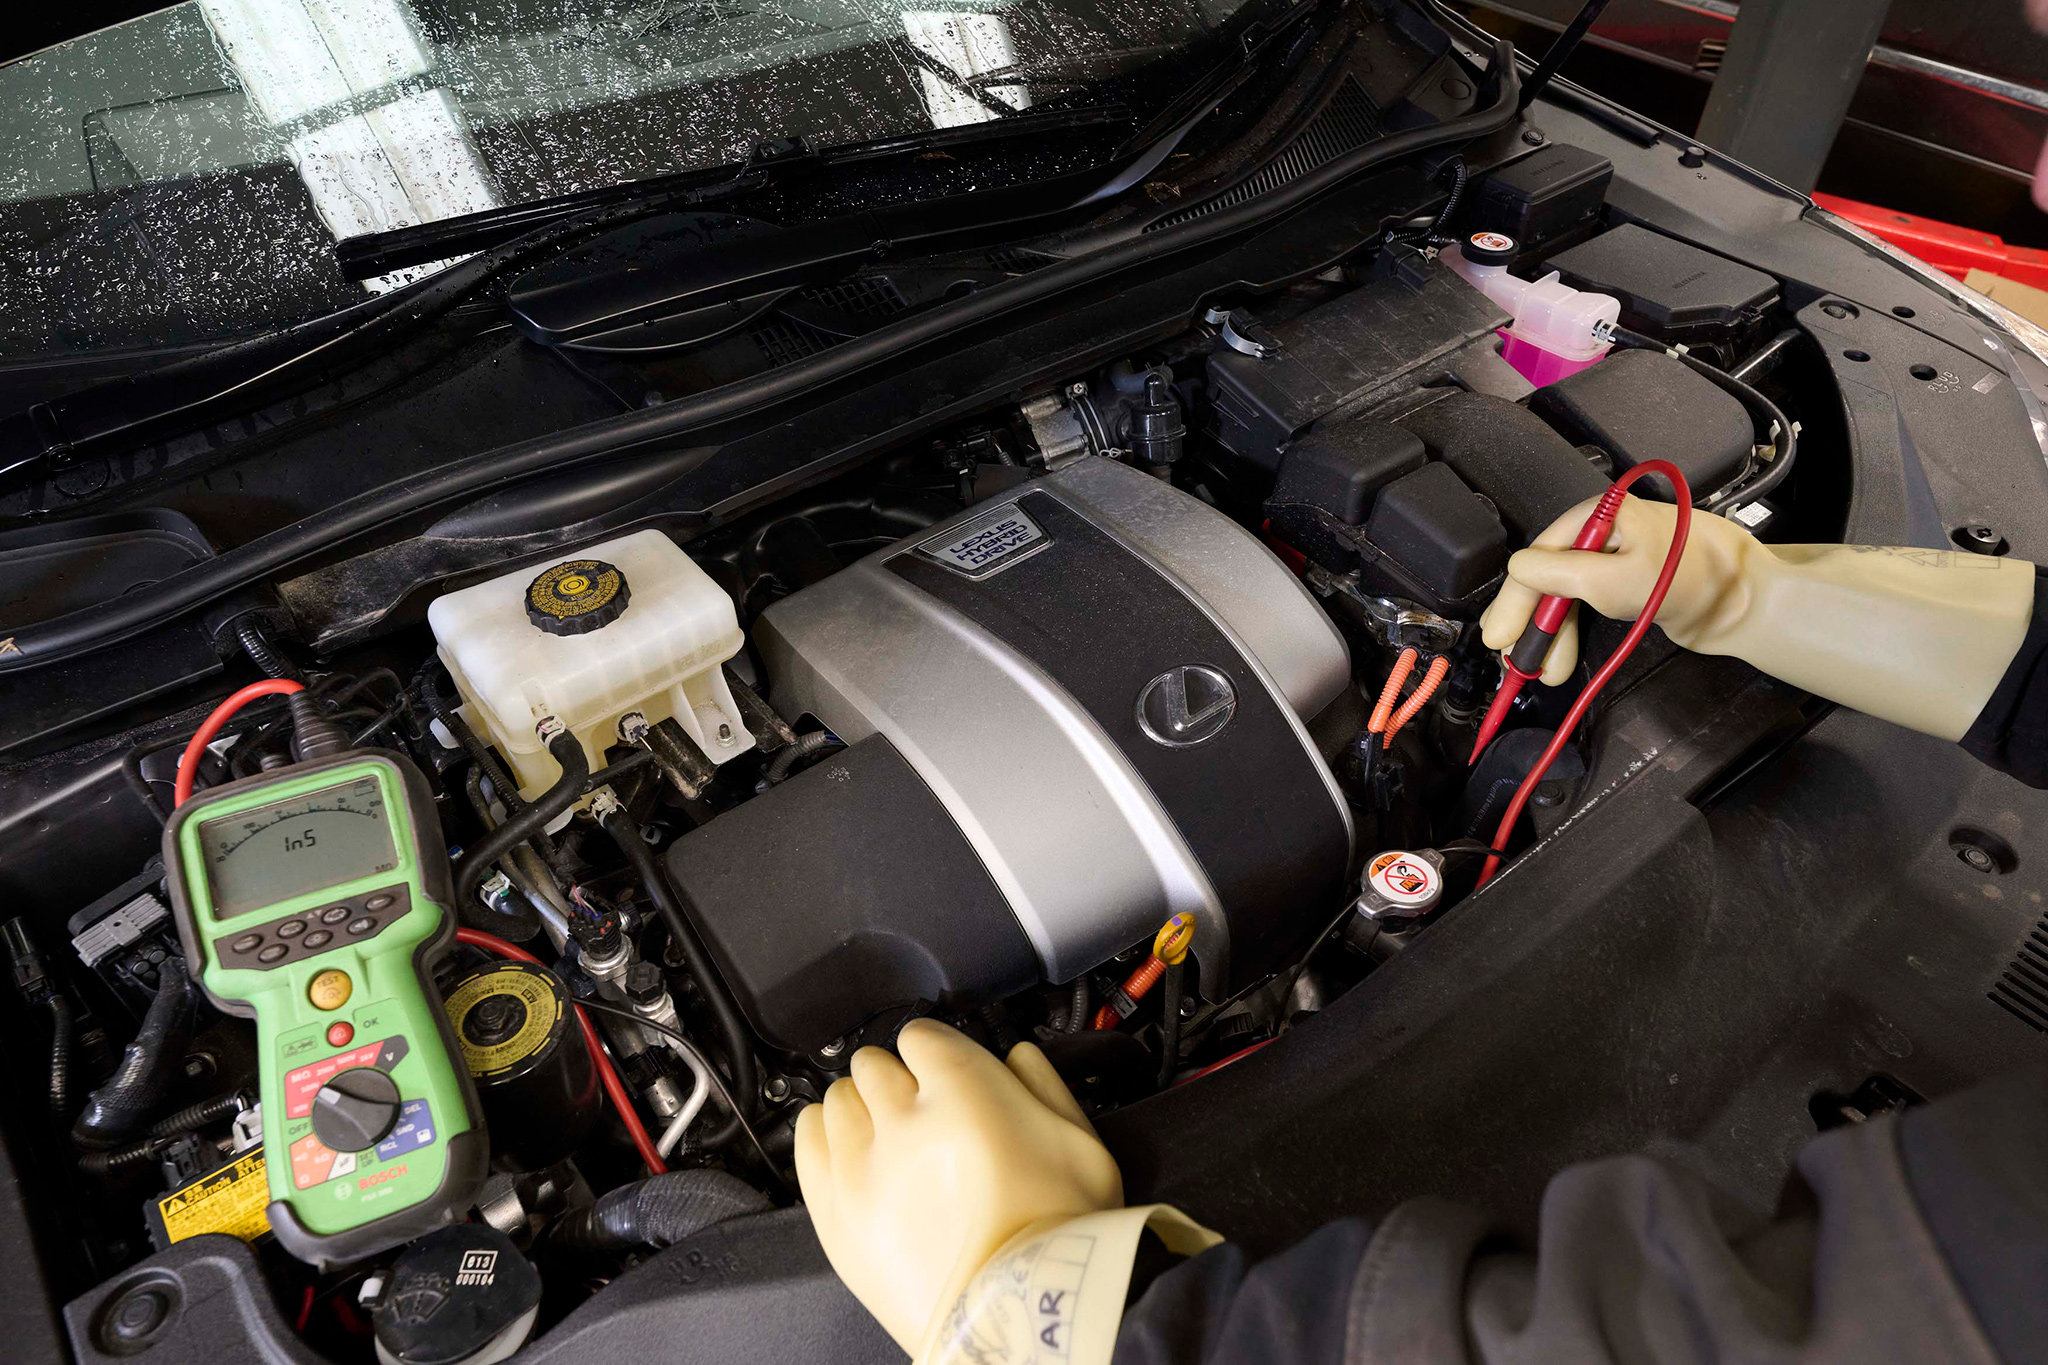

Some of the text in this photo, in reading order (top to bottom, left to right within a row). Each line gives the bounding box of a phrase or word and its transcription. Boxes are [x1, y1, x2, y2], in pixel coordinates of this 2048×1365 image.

[950, 519, 1018, 554] LEXUS
[956, 525, 1028, 561] HYBRID
[971, 532, 1033, 564] DRIVE
[317, 975, 339, 988] TEST
[363, 1017, 379, 1029] OK
[384, 1051, 395, 1062] V
[404, 1103, 422, 1115] DEL
[288, 1122, 310, 1135] OFF
[357, 1163, 409, 1191] BOSCH
[186, 1176, 232, 1205] CAUTION
